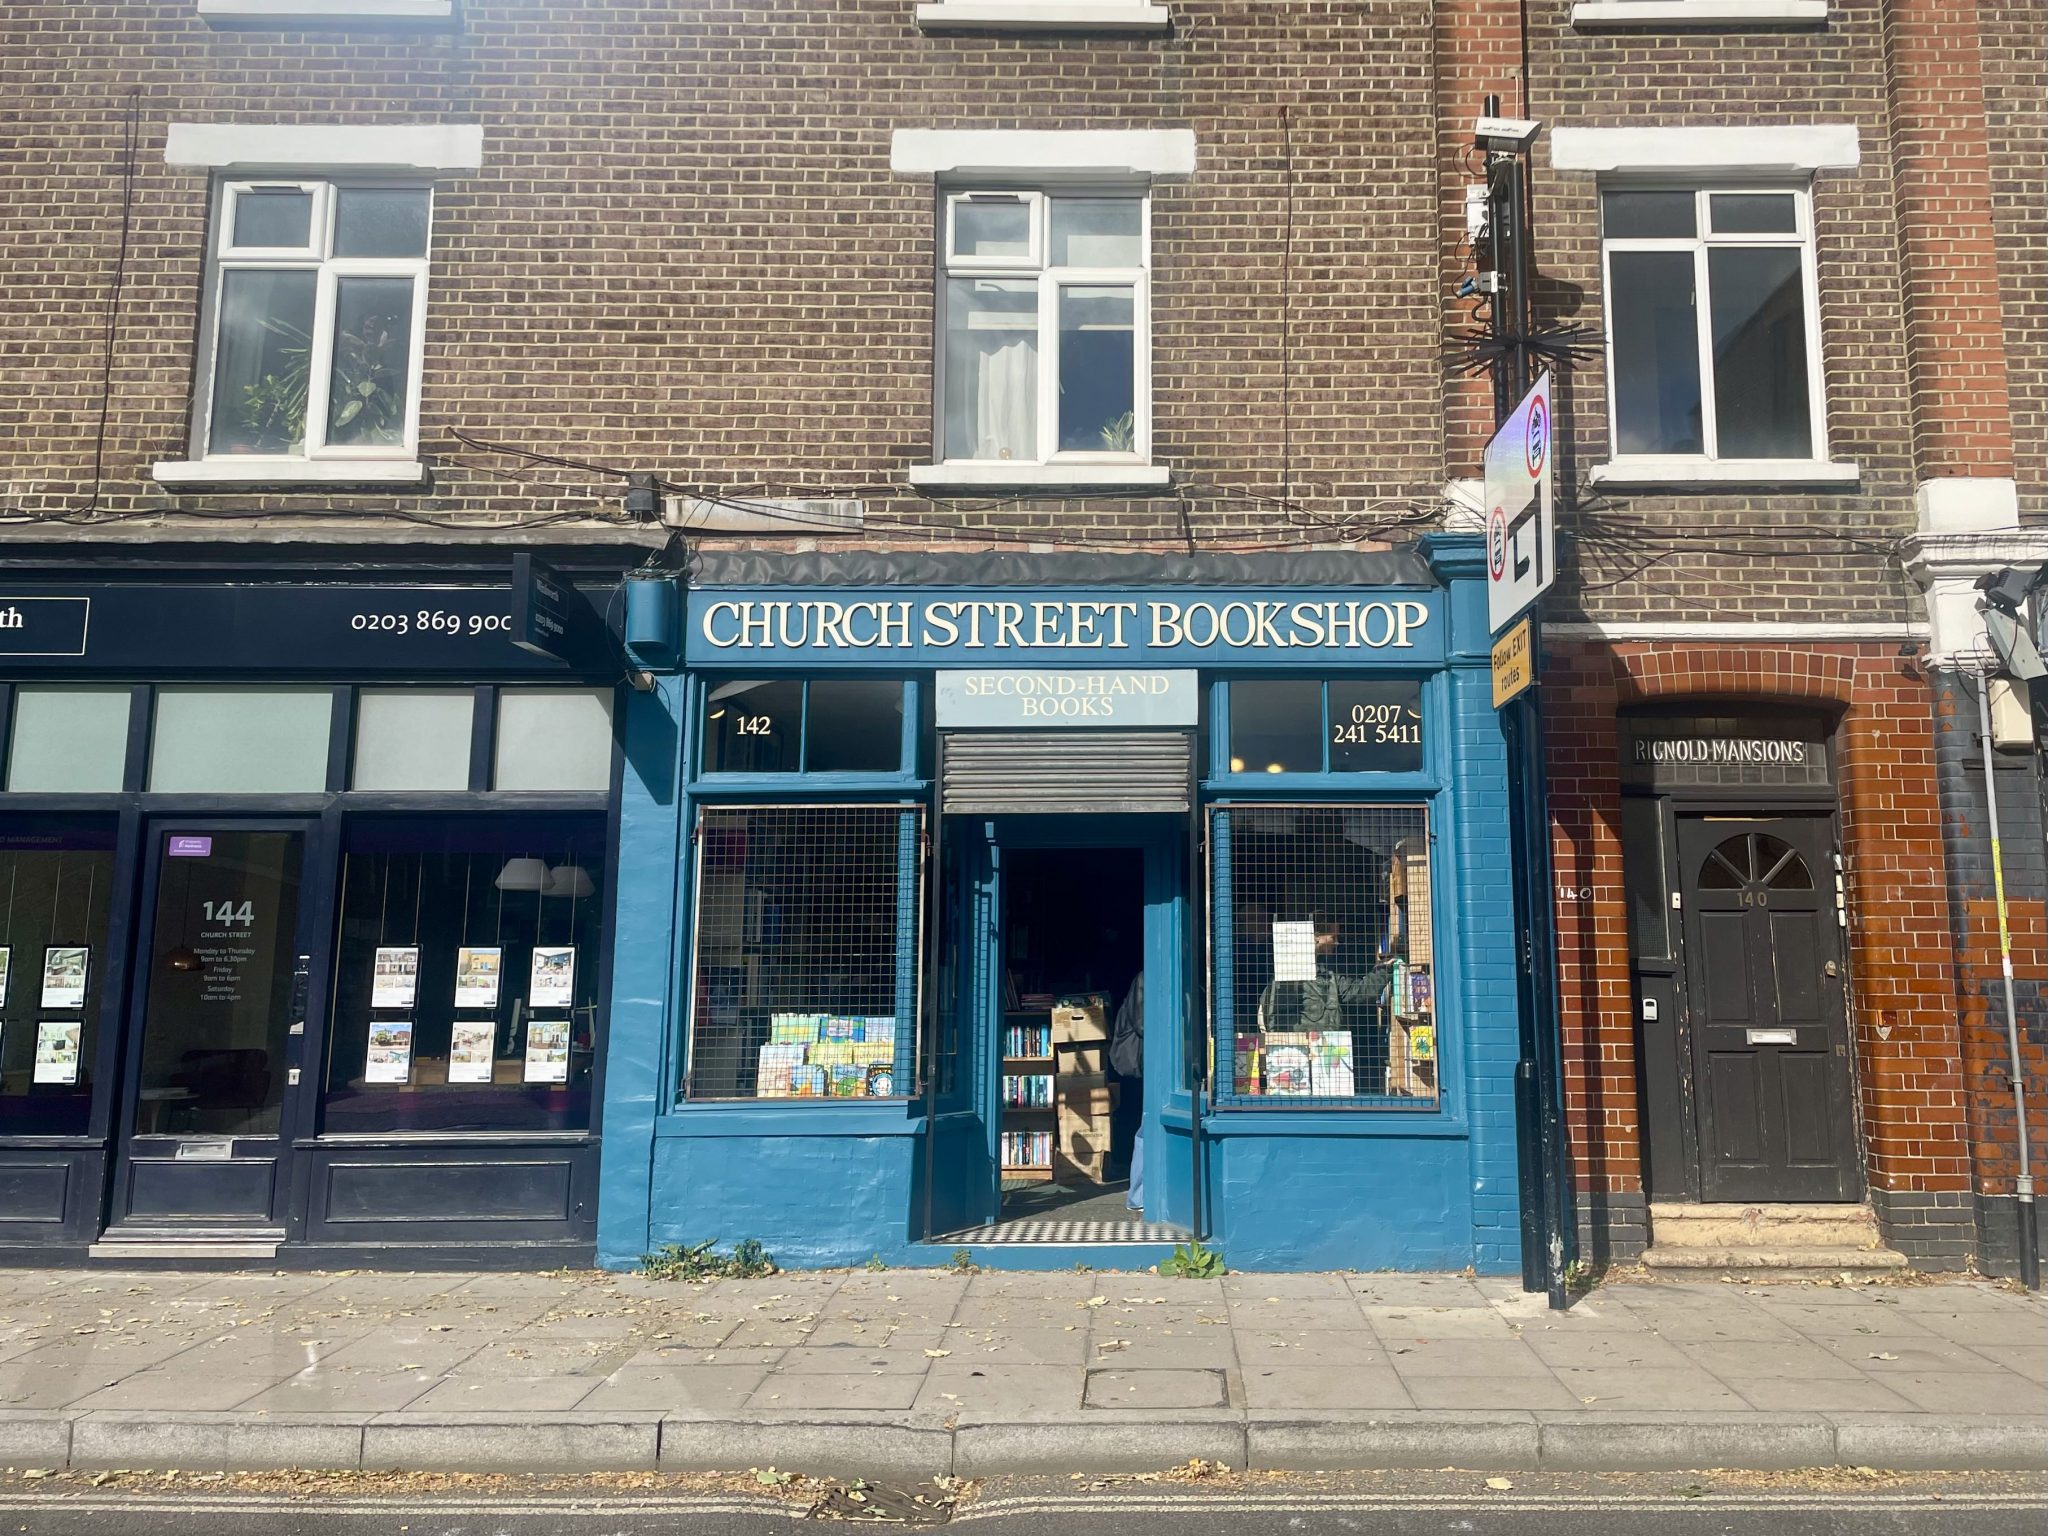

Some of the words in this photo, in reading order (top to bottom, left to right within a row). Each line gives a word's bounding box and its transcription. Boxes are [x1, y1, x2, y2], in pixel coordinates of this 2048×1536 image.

[351, 614, 409, 635] 0203
[416, 610, 461, 635] 869
[703, 601, 914, 648] CHURCH
[923, 601, 1138, 648] STREET
[1147, 601, 1429, 648] BOOKSHOP
[1493, 647, 1511, 672] Follow
[1512, 629, 1526, 657] EXIT
[965, 676, 1169, 696] SECOND-HAND
[1501, 666, 1520, 692] routes
[1022, 697, 1114, 717] BOOKS
[1351, 704, 1402, 724] 0207
[736, 716, 771, 735] 142
[1334, 724, 1368, 743] 241
[1375, 724, 1422, 743] 5411
[1713, 740, 1804, 762] MANSIONS
[1560, 887, 1592, 900] 140
[1736, 891, 1768, 907] 140
[203, 900, 255, 927] 144
[200, 931, 227, 939] CHURCH
[193, 948, 219, 956] Monday
[228, 947, 256, 956] Thursday
[213, 966, 232, 974] Friday
[207, 985, 235, 993] Saturday
